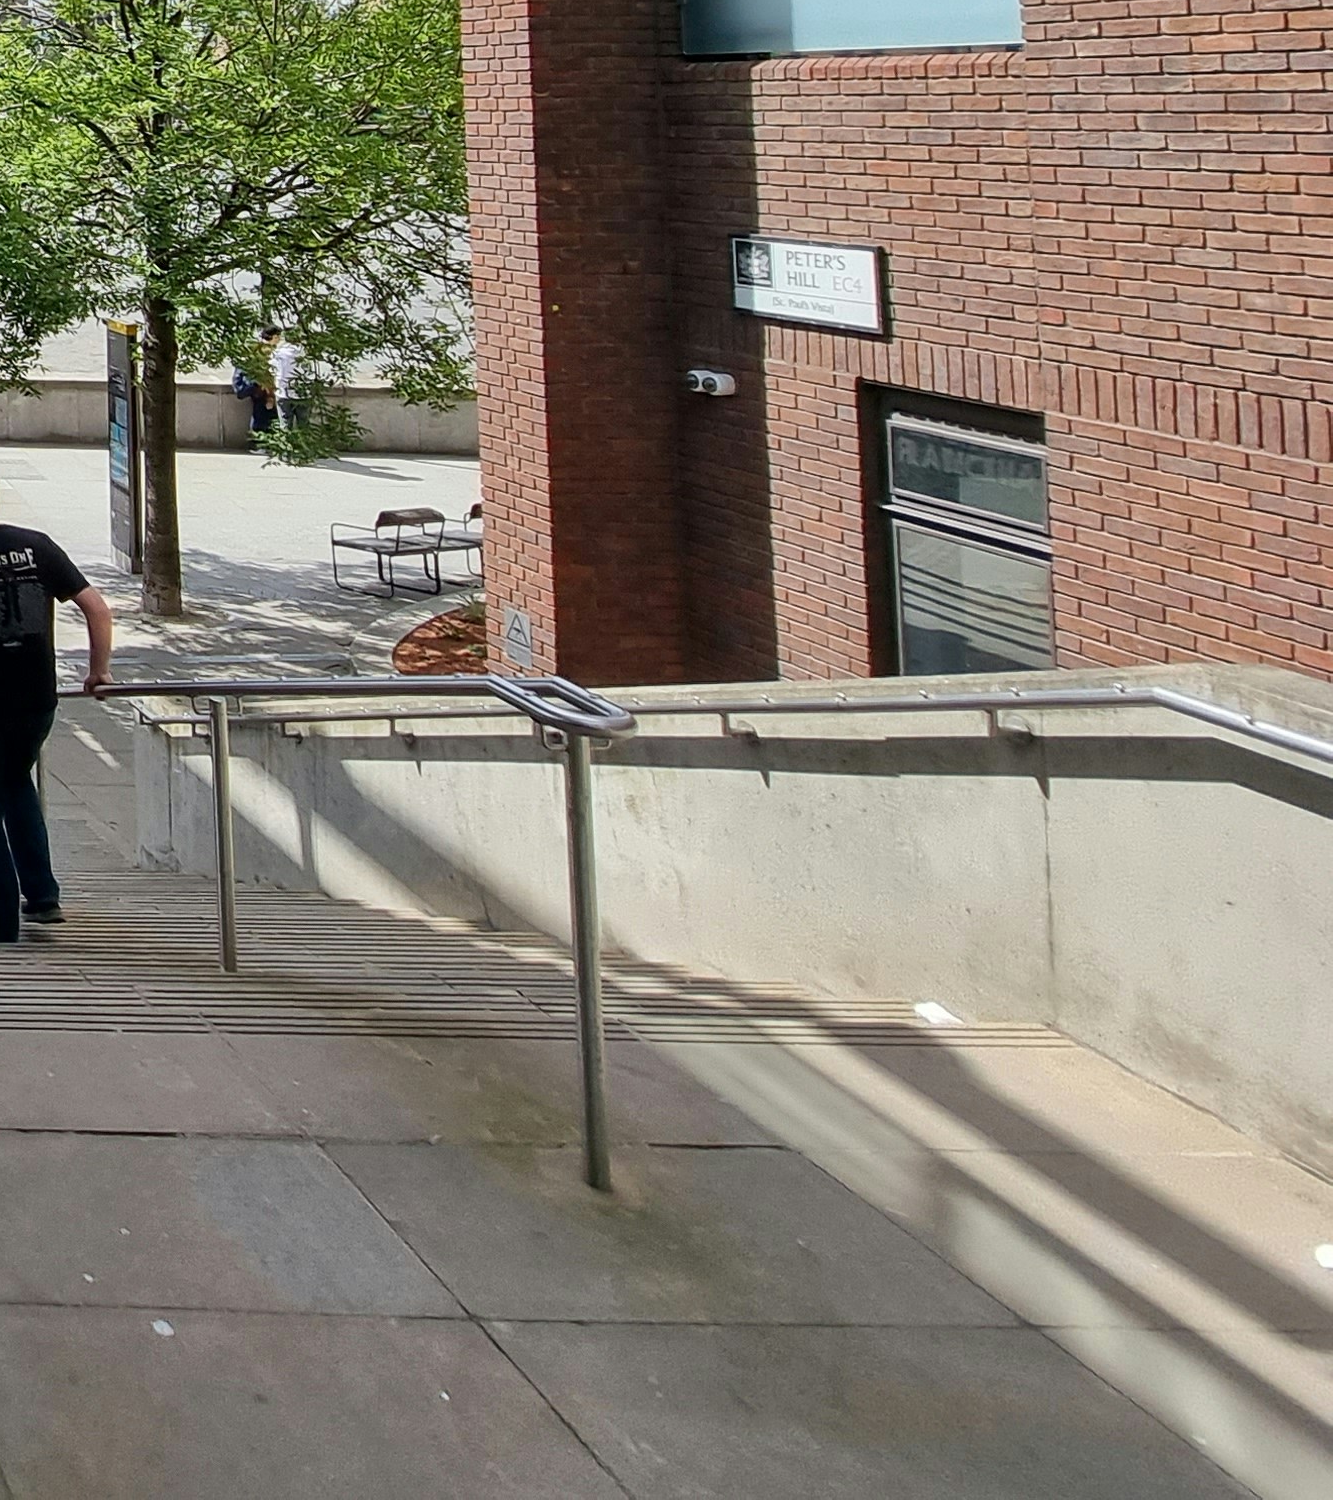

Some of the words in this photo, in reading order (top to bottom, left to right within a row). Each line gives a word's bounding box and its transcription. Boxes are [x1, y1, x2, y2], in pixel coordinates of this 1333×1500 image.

[786, 250, 846, 271] PETER'S
[787, 271, 820, 289] HILL
[833, 276, 863, 293] EC4
